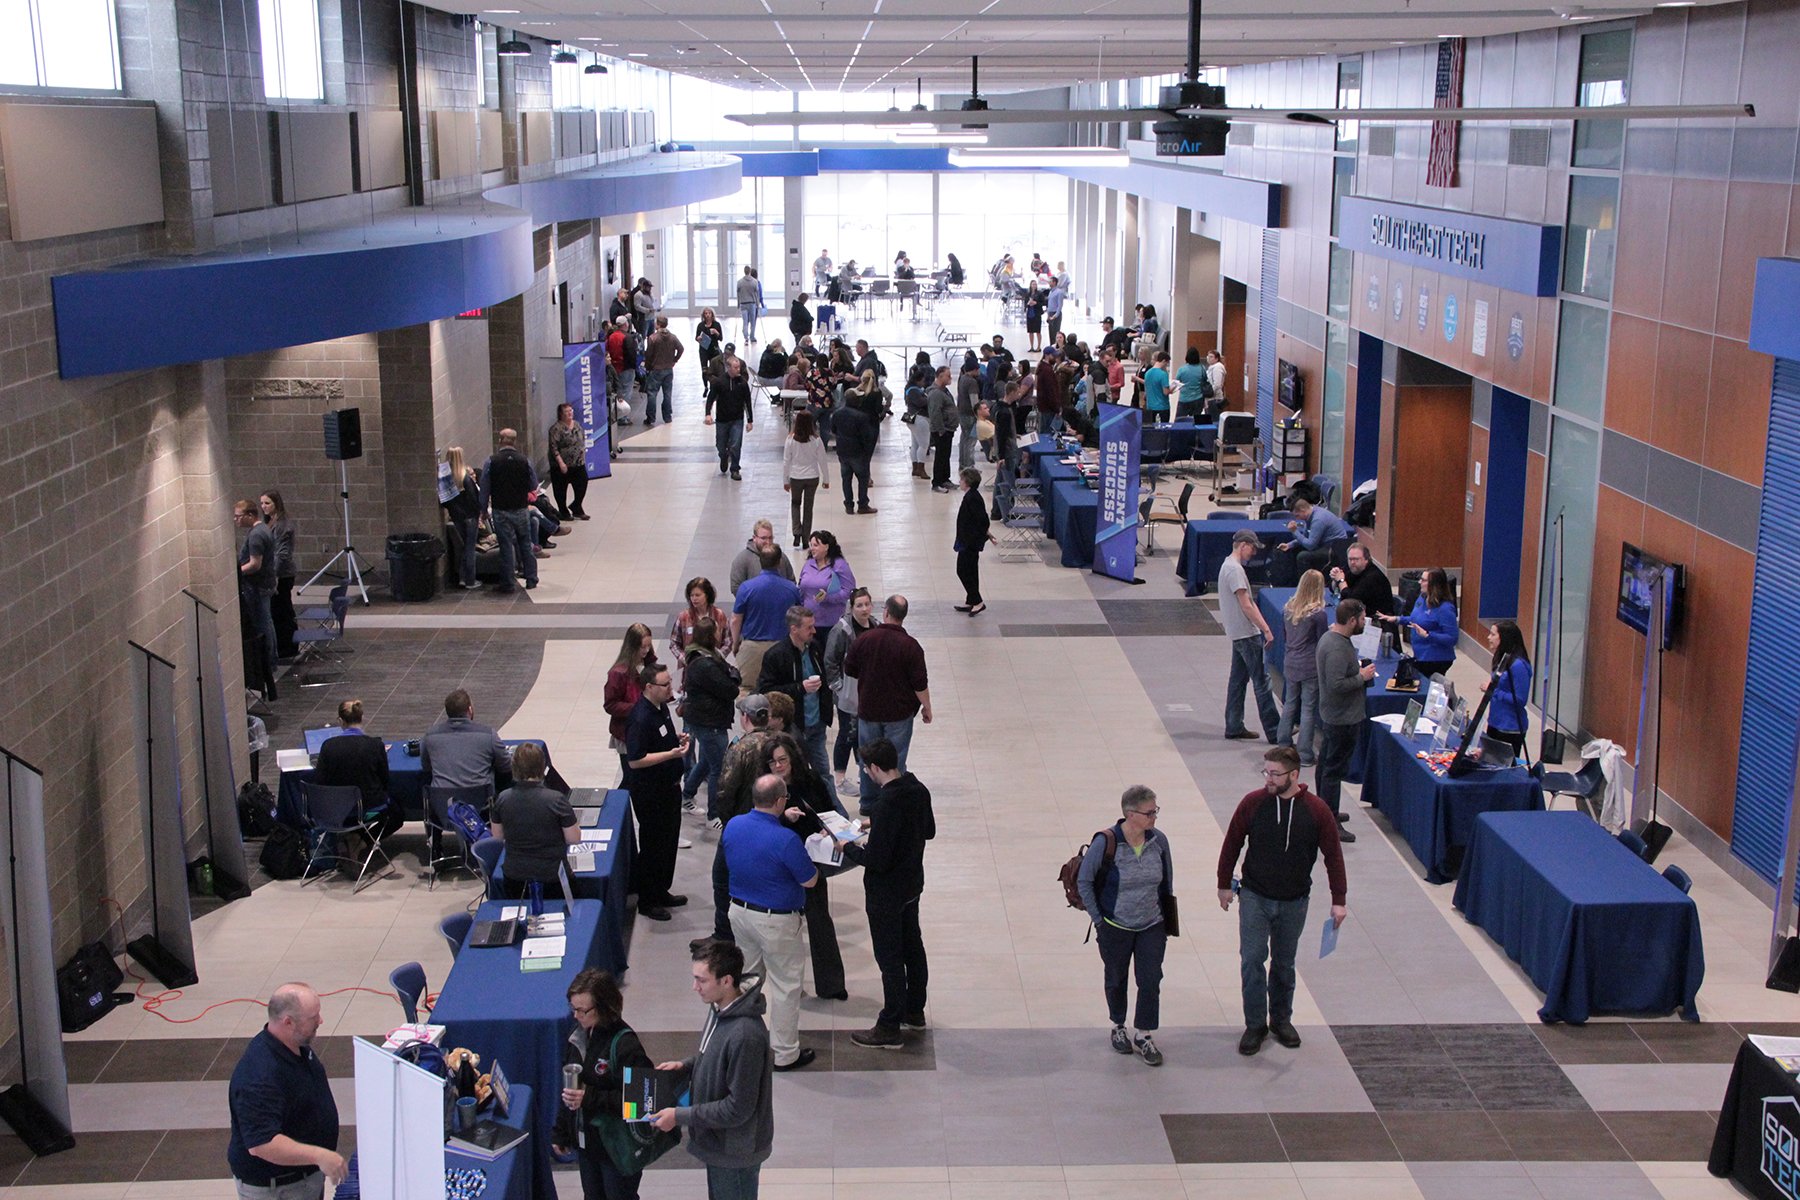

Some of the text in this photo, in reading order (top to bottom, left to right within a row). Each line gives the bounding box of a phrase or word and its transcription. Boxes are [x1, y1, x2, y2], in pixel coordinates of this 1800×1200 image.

[1371, 214, 1485, 269] SOUTHEAST TECH
[1511, 317, 1523, 329] BEST
[580, 355, 595, 453] STUDENT I.D.
[1104, 442, 1117, 522] SUCCESS
[1116, 440, 1129, 529] STUDENT
